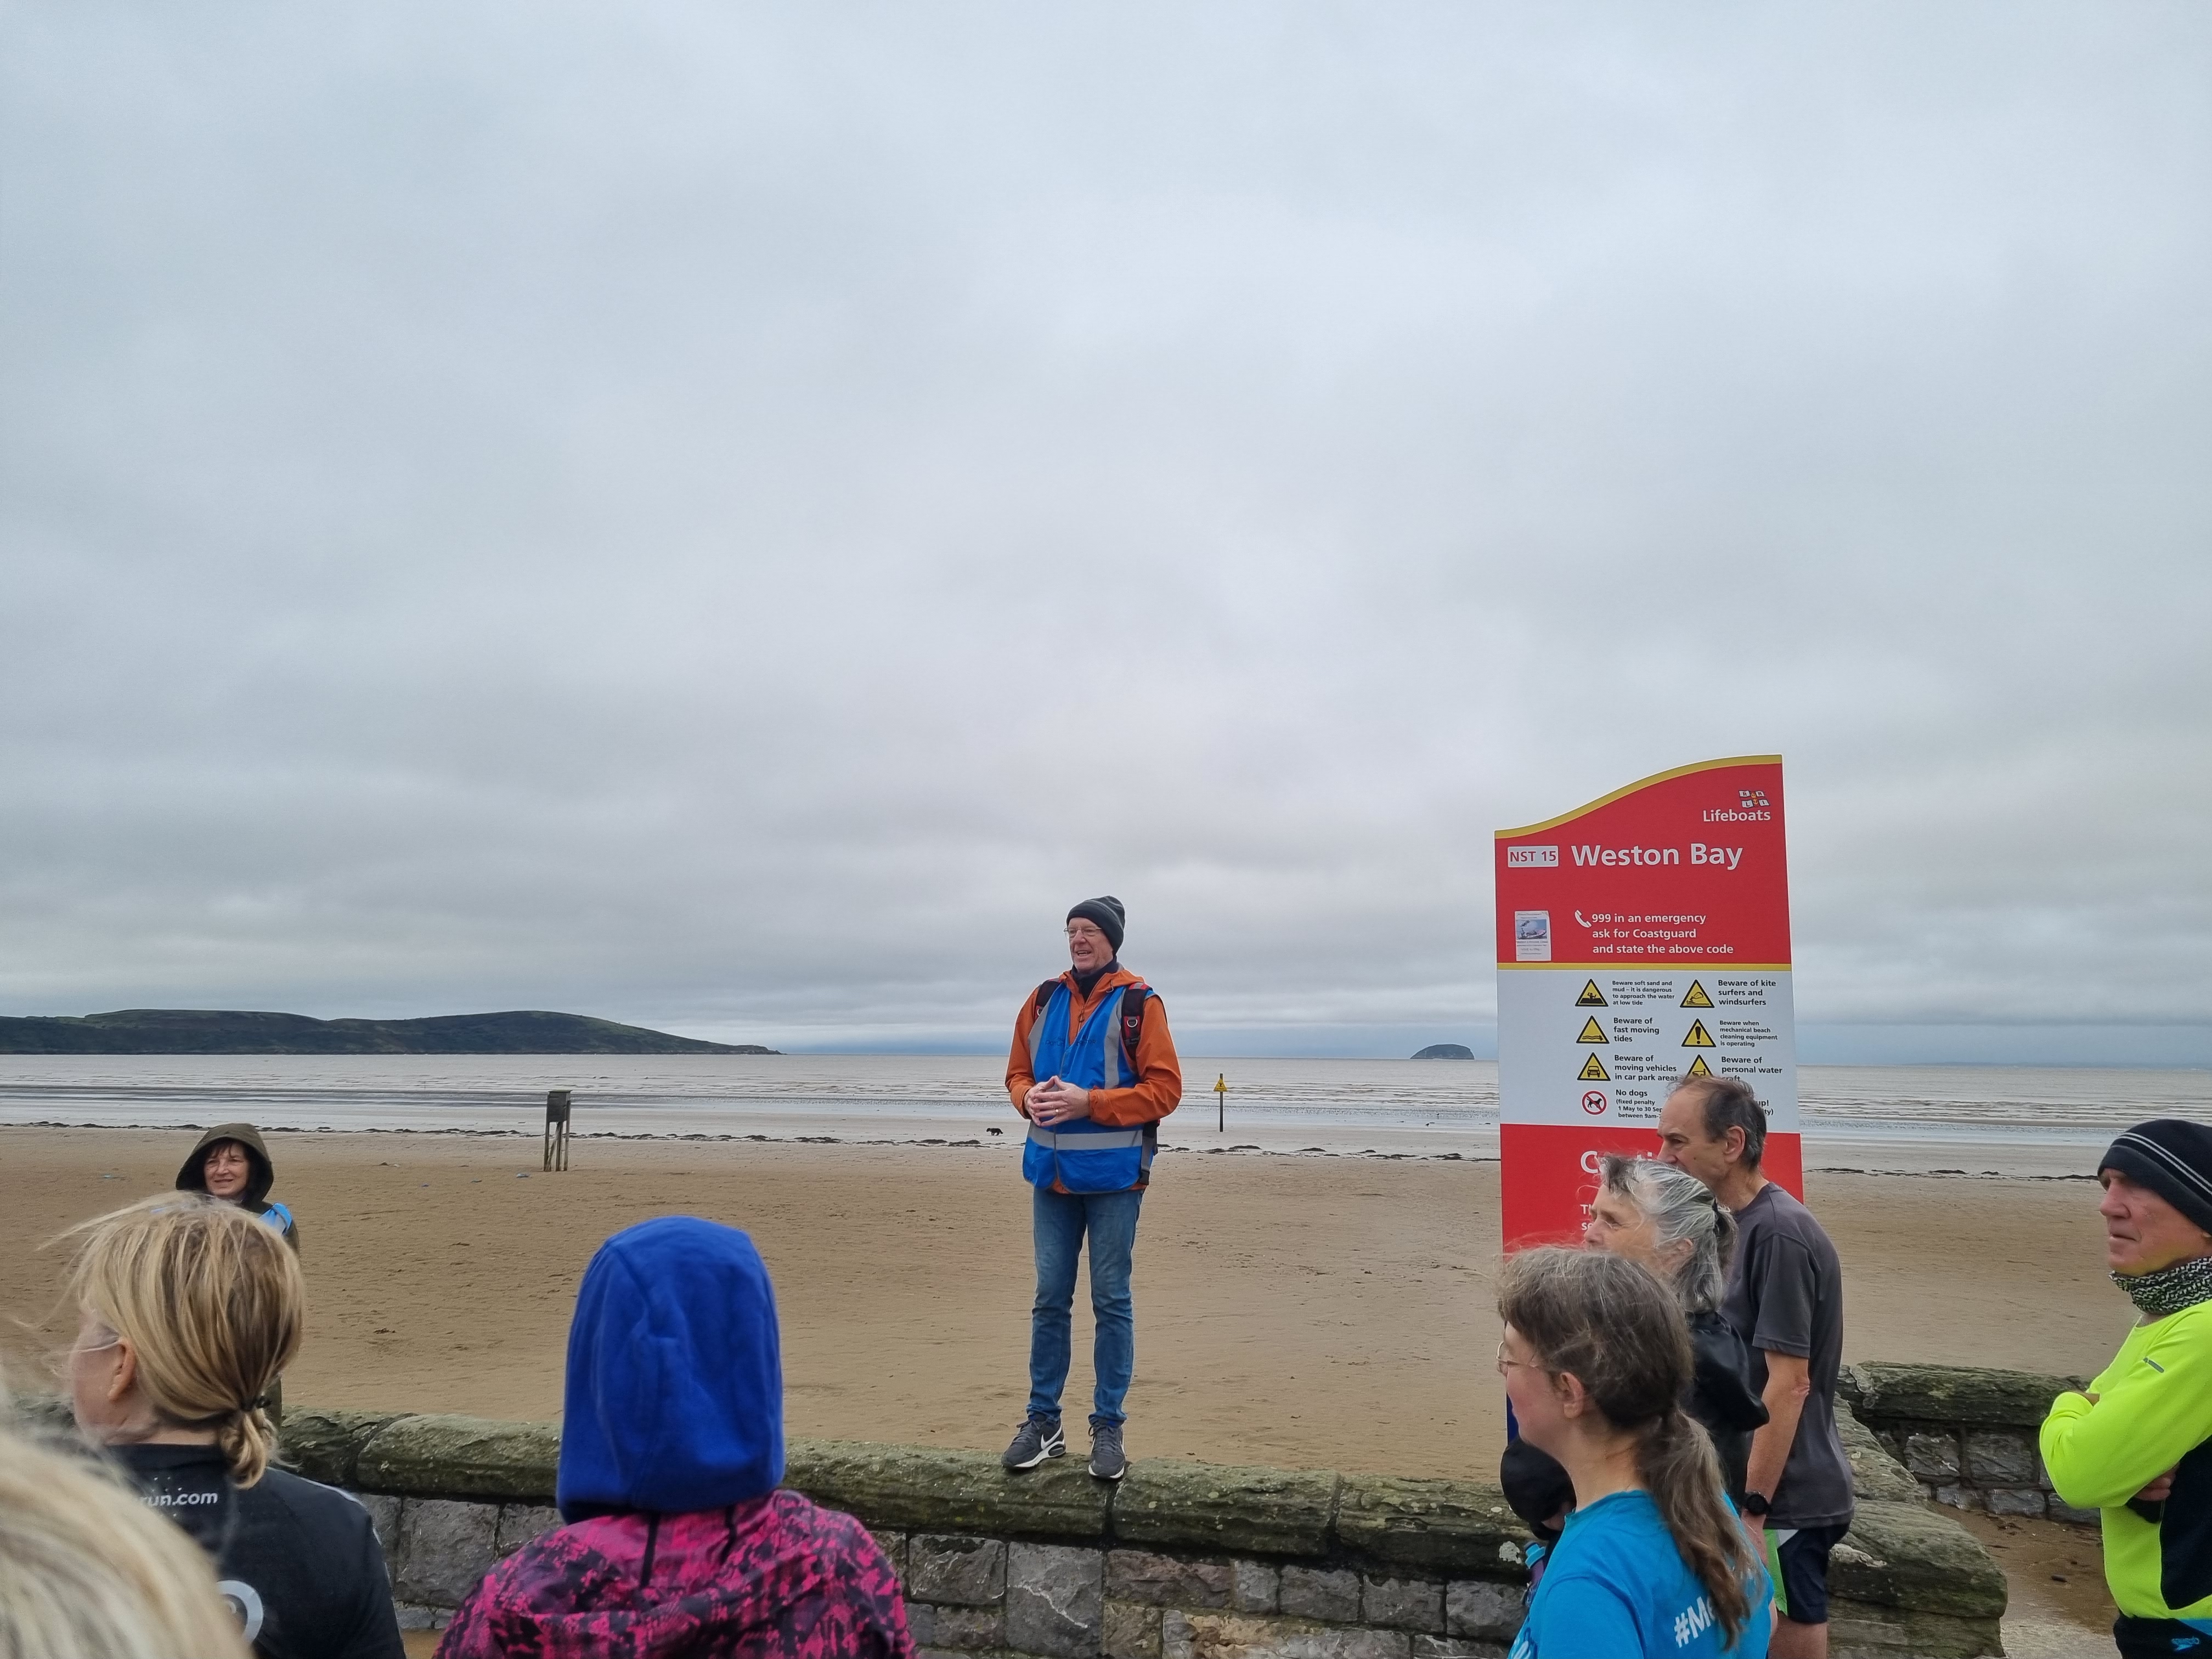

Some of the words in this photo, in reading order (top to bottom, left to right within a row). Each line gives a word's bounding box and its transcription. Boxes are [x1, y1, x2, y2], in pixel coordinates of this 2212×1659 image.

[1703, 809, 1771, 822] Lifeboats
[1510, 851, 1537, 862] NST
[1541, 851, 1556, 861] 15
[1571, 845, 1679, 866] Weston
[1690, 843, 1743, 871] Bay
[1592, 913, 1611, 923] 999
[1615, 913, 1624, 922] in
[1645, 915, 1706, 924] emergency
[1592, 929, 1611, 938] ask
[1613, 929, 1629, 938] for
[1633, 929, 1696, 940] Coastguard
[1593, 944, 1613, 953] and
[1617, 945, 1644, 953] state
[1647, 944, 1666, 953] the
[1668, 944, 1703, 953] above
[1706, 944, 1734, 953] code
[1630, 1026, 1660, 1035] moving
[1615, 1064, 1644, 1073] moving
[1638, 1074, 1656, 1082] park
[1629, 1089, 1648, 1098] dogs
